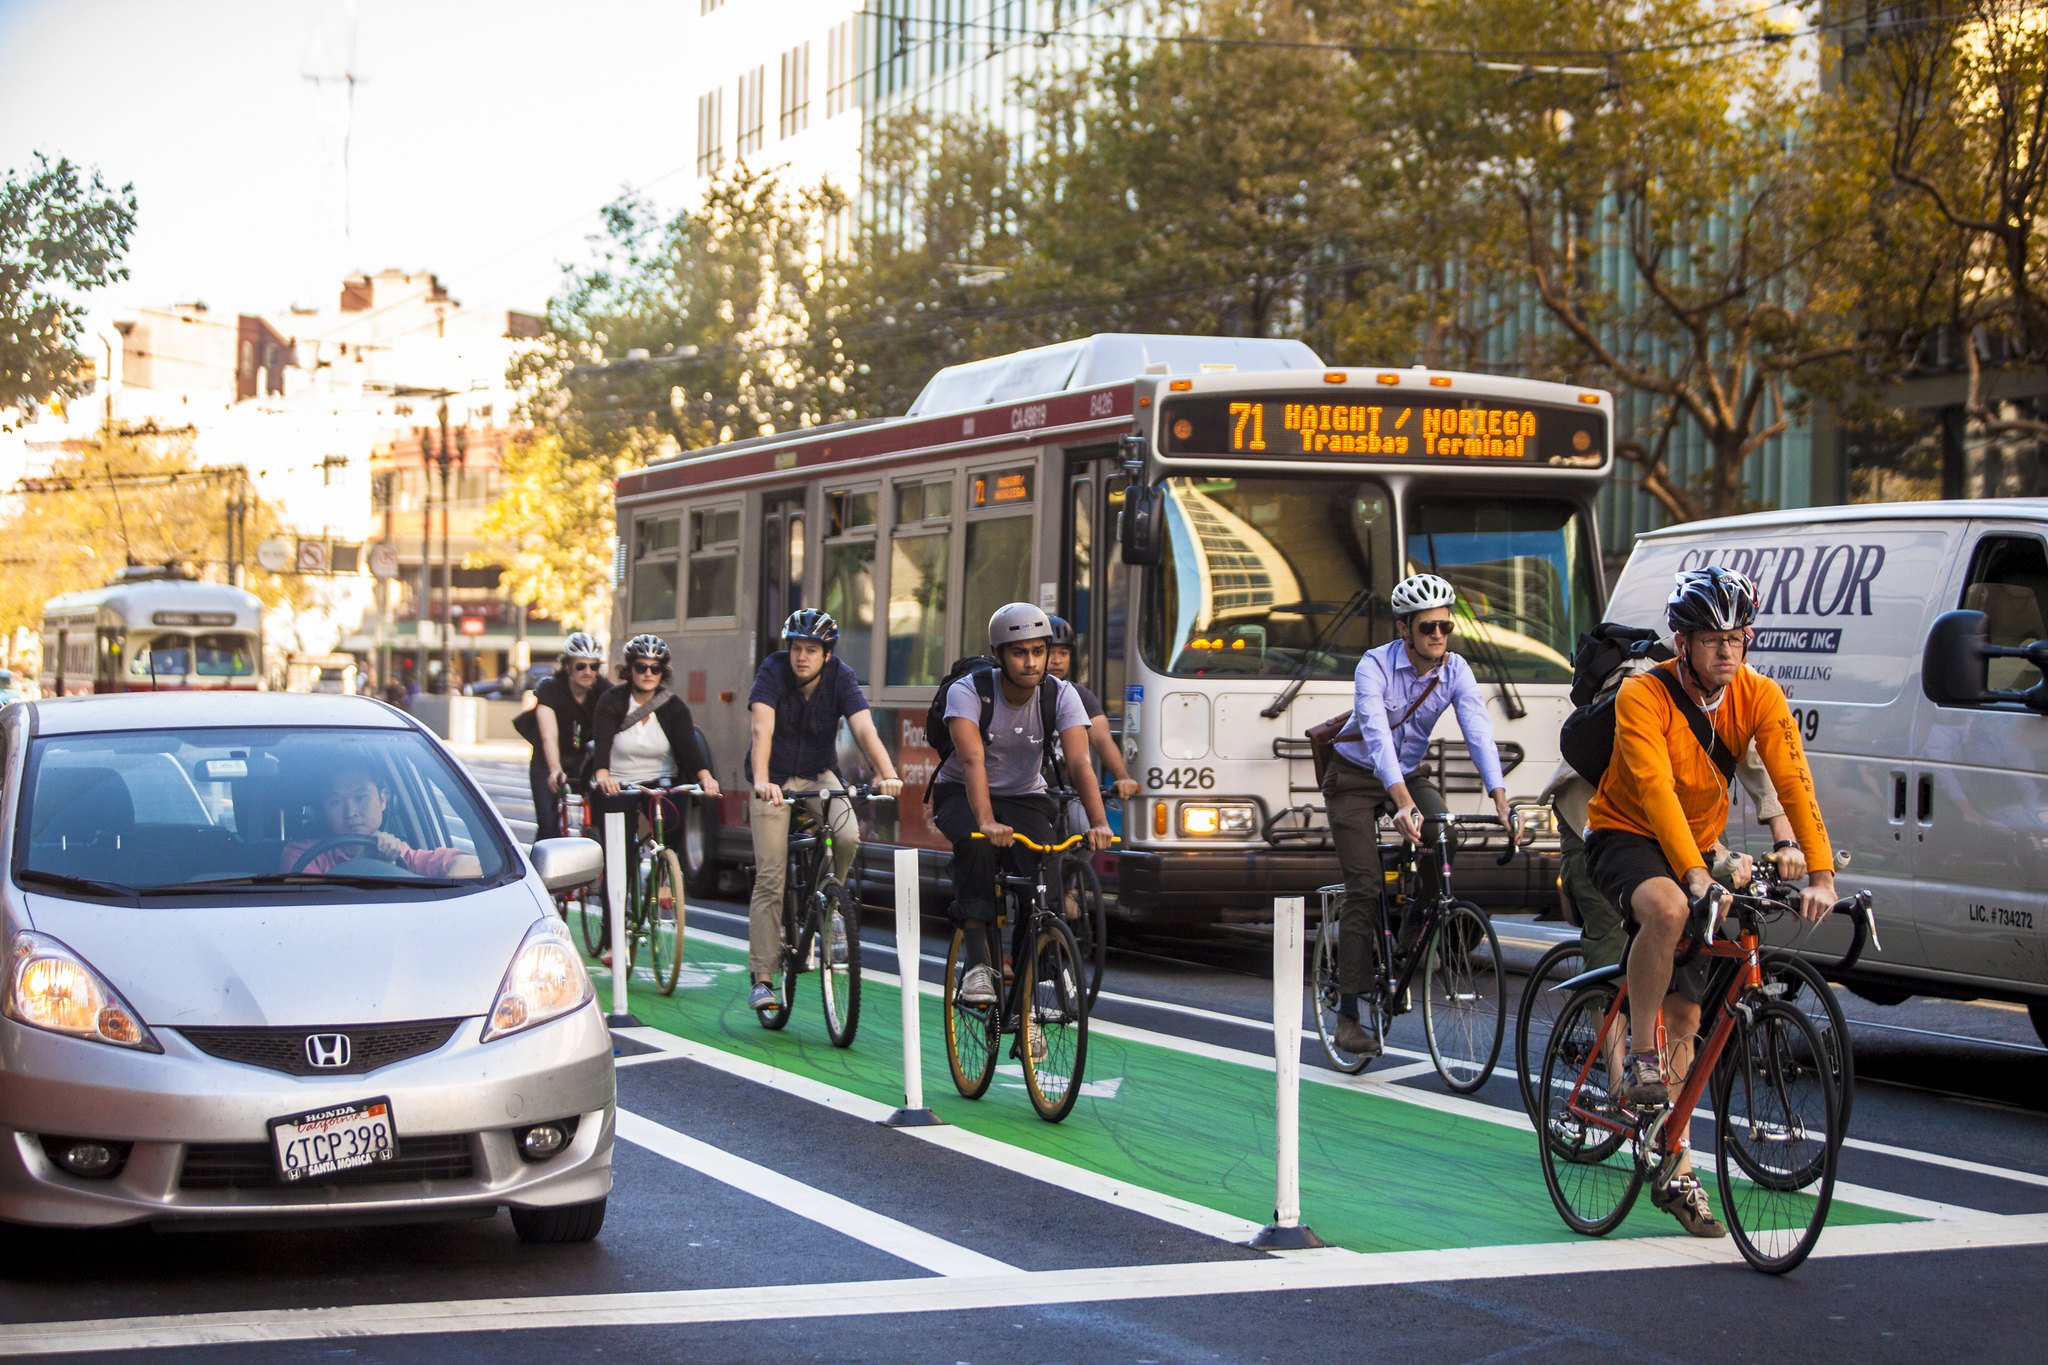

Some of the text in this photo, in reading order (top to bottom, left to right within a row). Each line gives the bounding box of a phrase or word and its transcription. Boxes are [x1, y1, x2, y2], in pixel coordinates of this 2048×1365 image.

[1229, 402, 1266, 450] 71
[1284, 404, 1383, 431] HAIGHT
[1422, 408, 1536, 437] NORIEGA
[1300, 428, 1525, 457] Transbay Terminal
[1756, 631, 1836, 650] CUTTING INC.
[1777, 665, 1832, 681] DRILLING
[1147, 767, 1215, 790] 8426
[1969, 904, 1989, 923] LIC.
[297, 1112, 362, 1133] California
[305, 1106, 356, 1122] HONDA
[285, 1122, 388, 1169] 6TCP398
[308, 1160, 337, 1176] SANTA
[337, 1152, 373, 1170] MONICA
